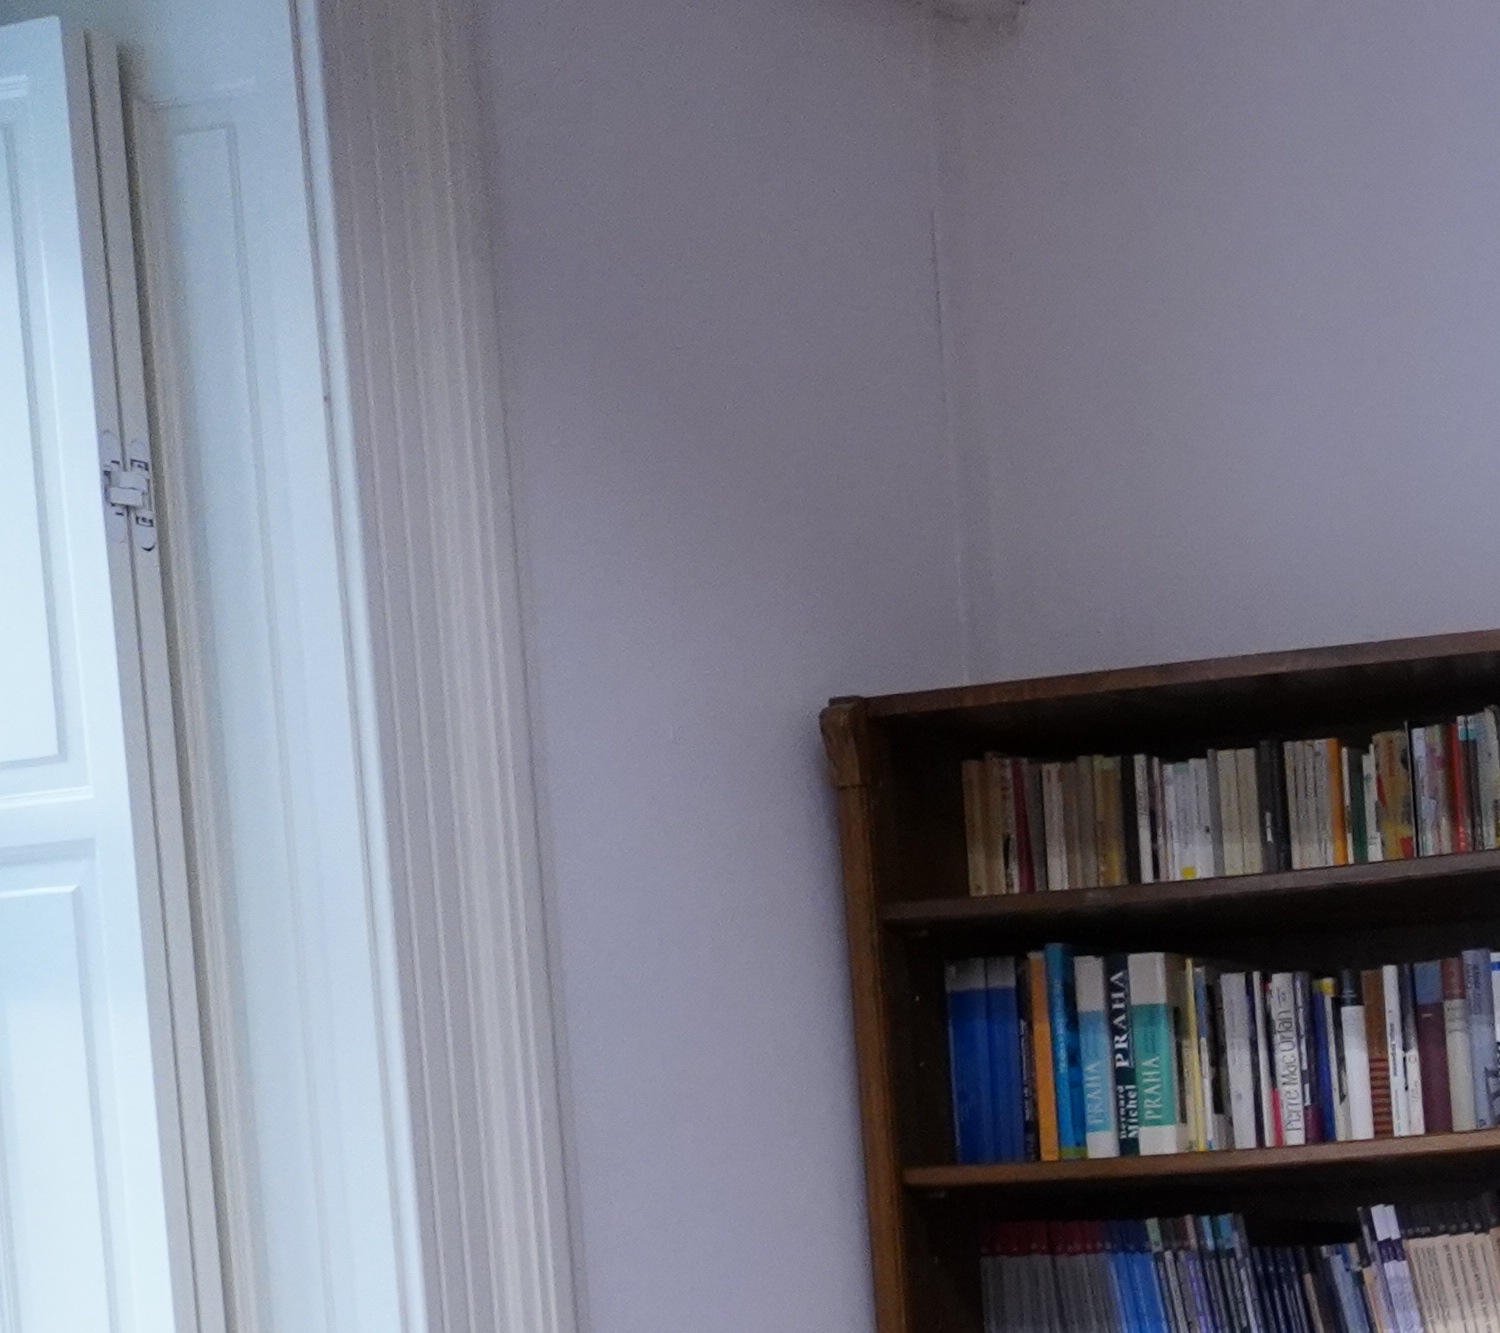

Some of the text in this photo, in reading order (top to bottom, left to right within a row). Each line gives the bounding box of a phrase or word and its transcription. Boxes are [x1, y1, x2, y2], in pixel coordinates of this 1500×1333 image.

[1110, 970, 1131, 1067] PRAHA
[1126, 1084, 1138, 1139] Michel
[1142, 1056, 1162, 1121] PRAHA
